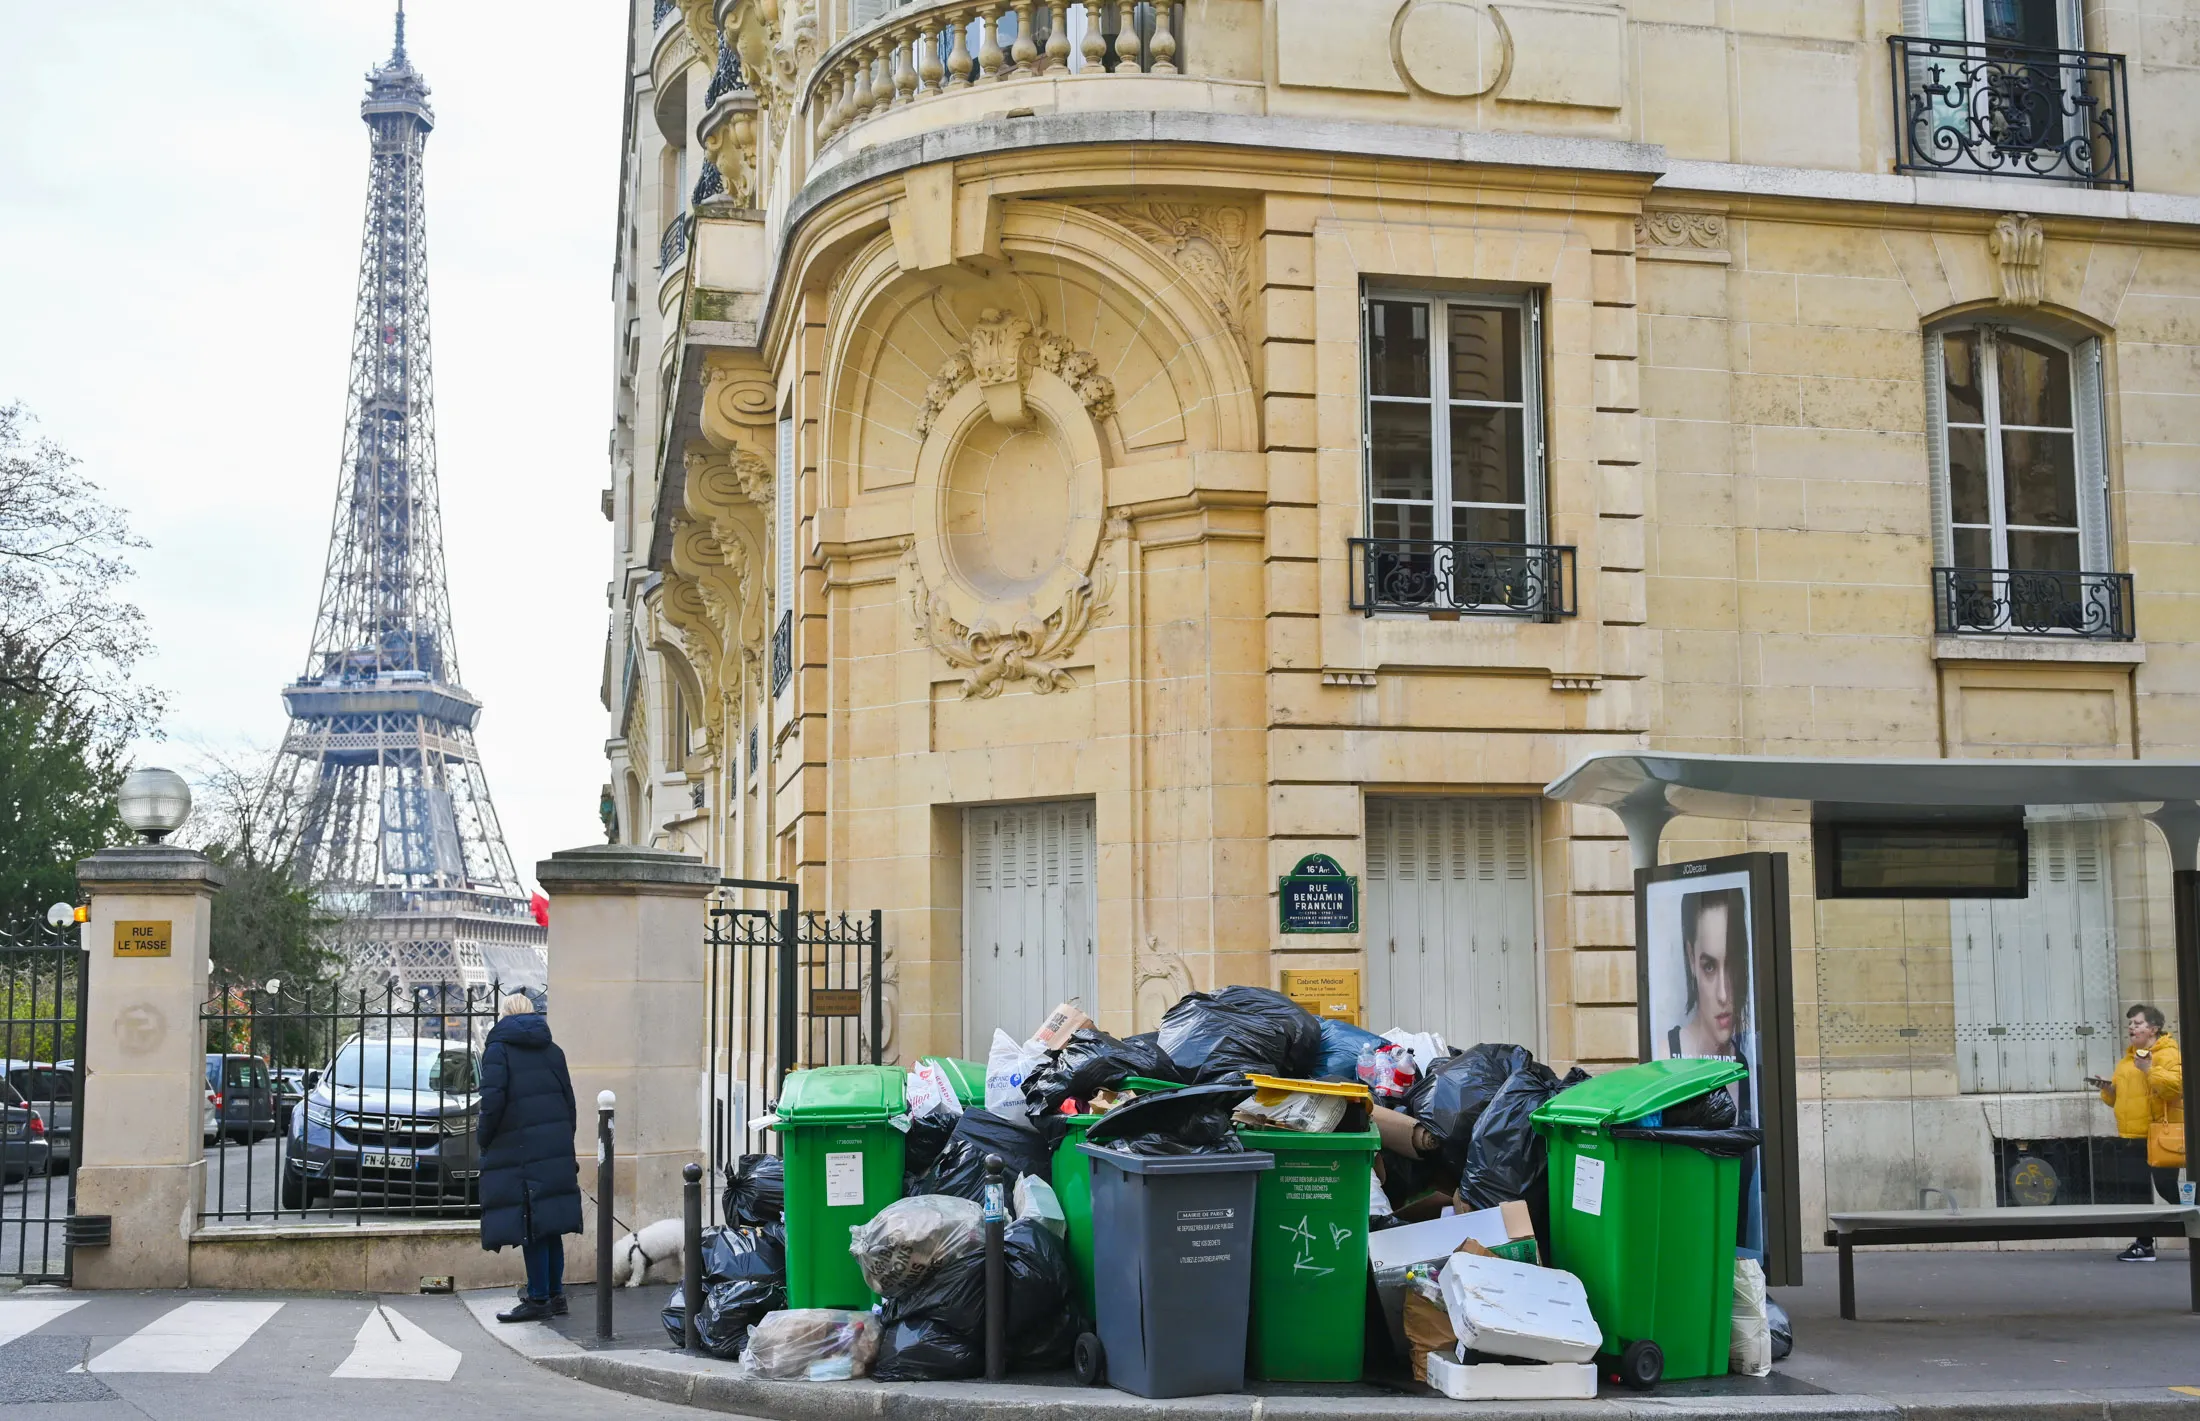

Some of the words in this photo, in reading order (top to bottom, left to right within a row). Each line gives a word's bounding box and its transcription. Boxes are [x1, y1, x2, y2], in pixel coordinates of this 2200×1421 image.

[1682, 864, 1708, 875] JCDecaux
[1308, 884, 1328, 892] RUE
[1293, 893, 1344, 901] BENJAMIN
[1295, 902, 1343, 910] FRANKLIN
[132, 927, 154, 937] RUE
[118, 940, 131, 950] LE
[134, 940, 167, 950] TASSE
[1002, 1099, 1026, 1107] VESTIAIR
